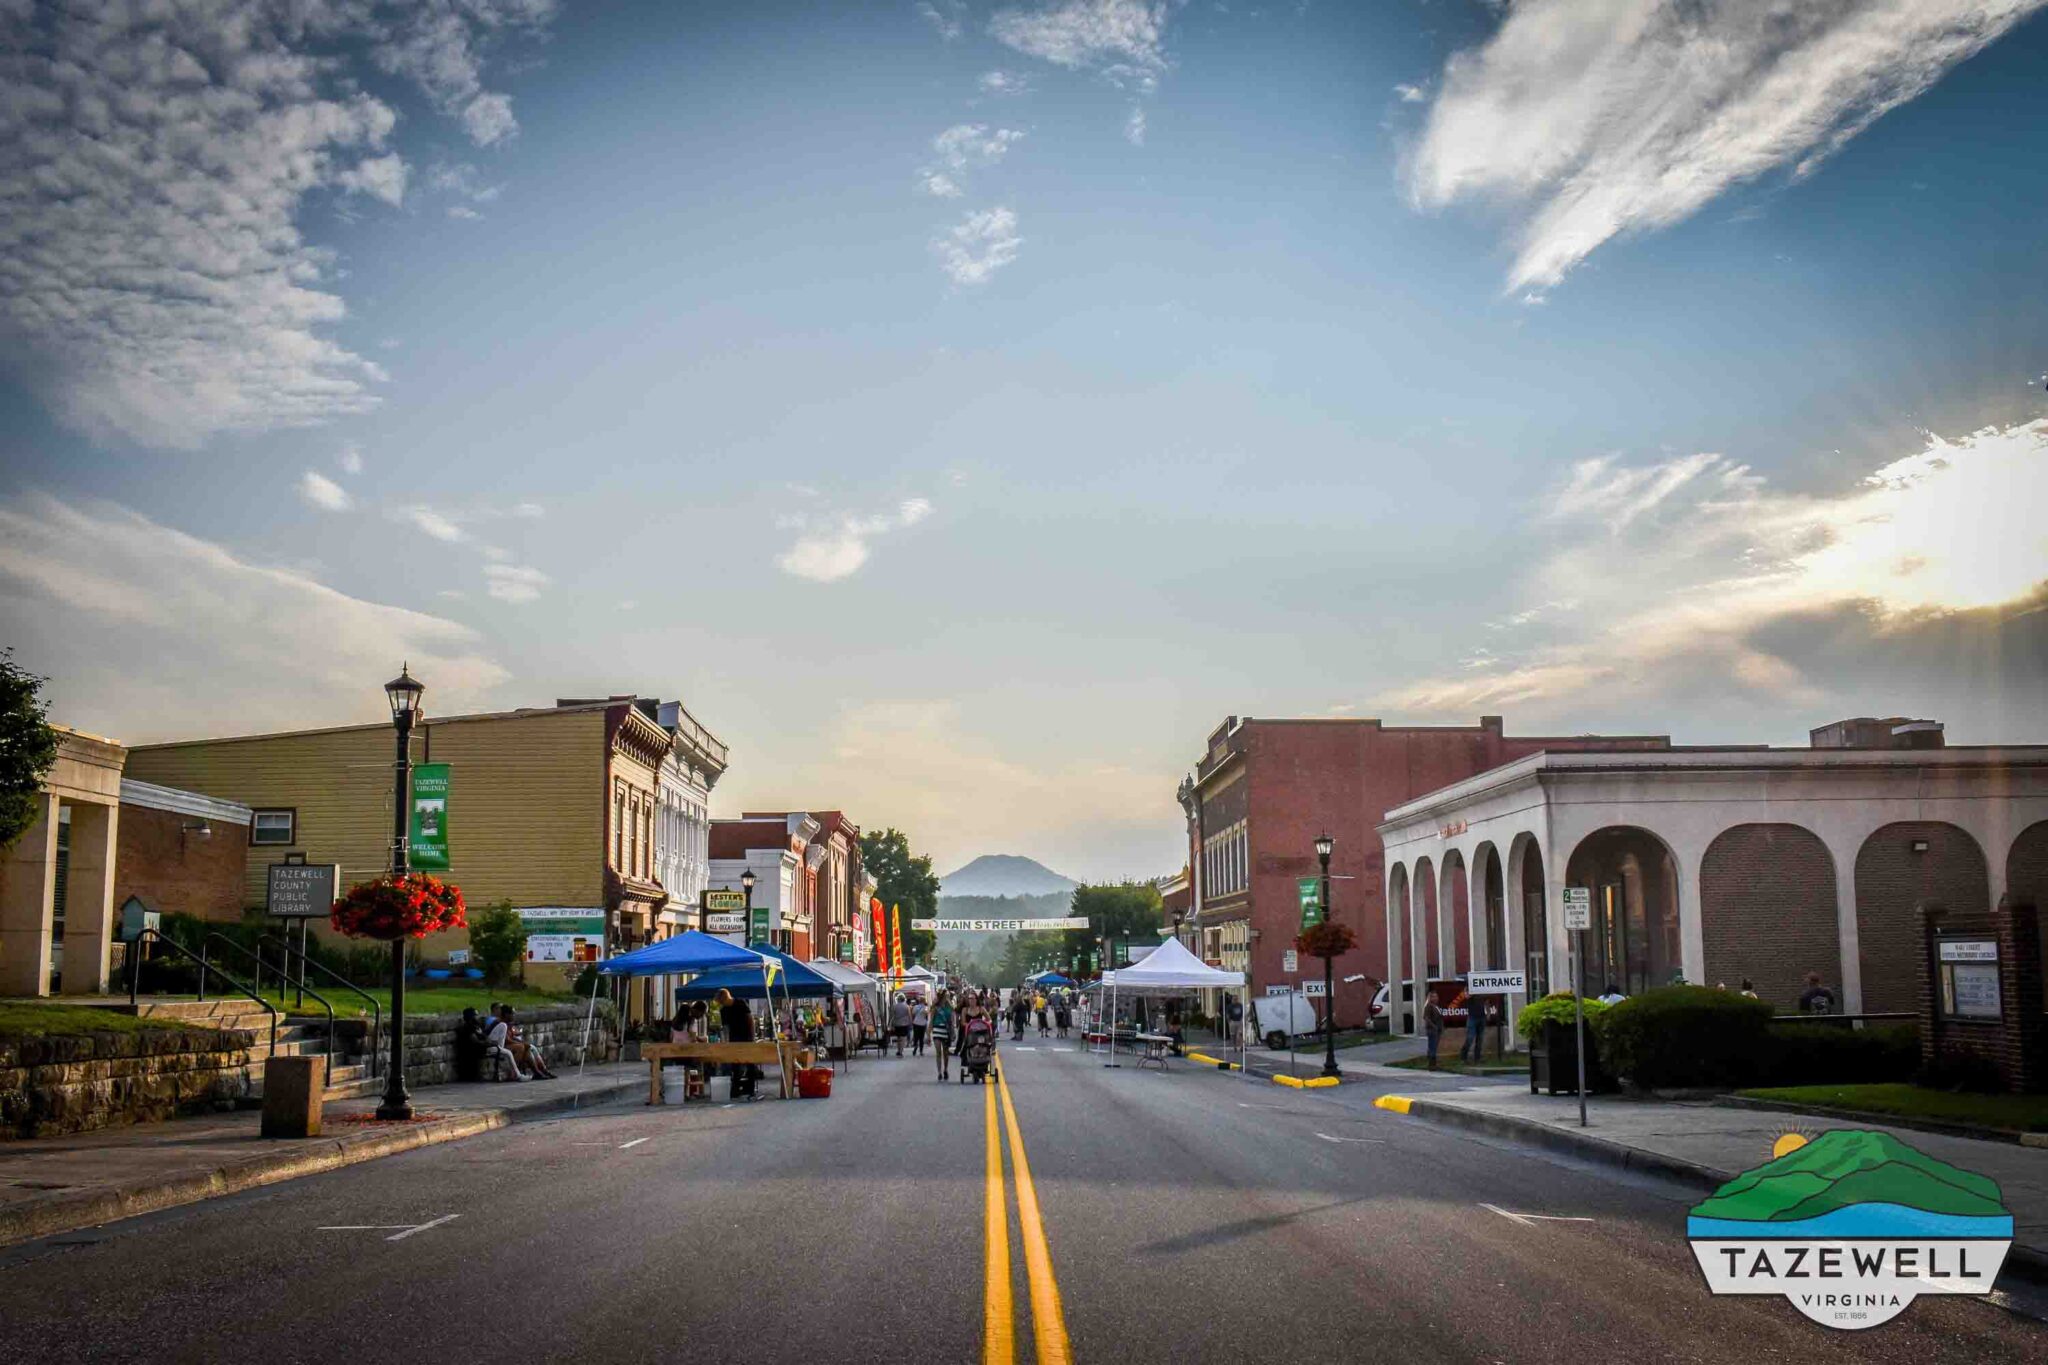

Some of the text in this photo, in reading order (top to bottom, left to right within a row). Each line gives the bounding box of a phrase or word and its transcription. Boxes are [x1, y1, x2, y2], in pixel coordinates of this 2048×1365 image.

[274, 869, 324, 879] TAZEWELL
[273, 881, 312, 890] COUNTY
[273, 892, 308, 901] PUBLIC
[1564, 890, 1570, 901] 2
[272, 903, 312, 913] LIBRARY
[940, 920, 971, 930] MAIN
[974, 920, 1025, 930] STREET
[1472, 977, 1523, 988] ENTRANCE
[1306, 984, 1326, 993] EXI
